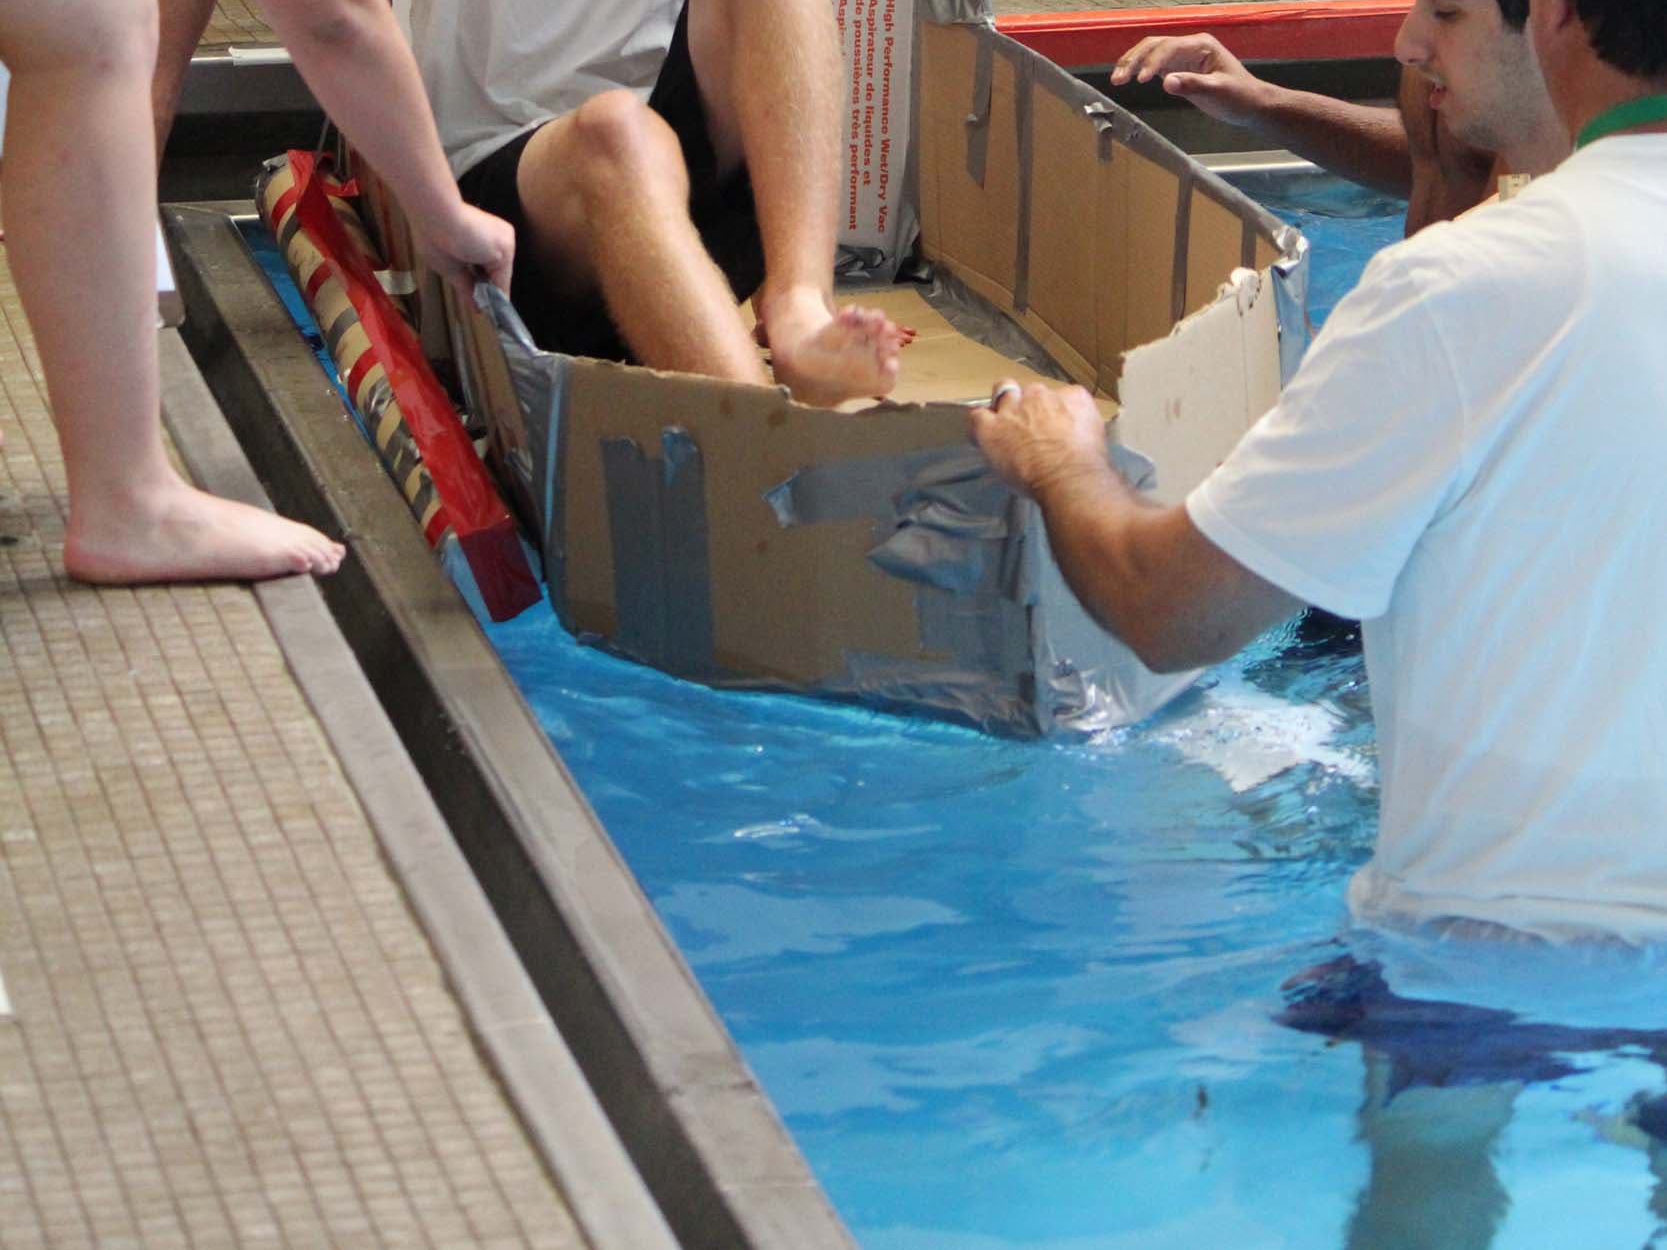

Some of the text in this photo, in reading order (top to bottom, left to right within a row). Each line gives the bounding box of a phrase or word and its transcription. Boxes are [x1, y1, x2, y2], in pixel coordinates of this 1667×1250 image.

[852, 20, 862, 105] poussières
[865, 82, 875, 101] de
[881, 37, 894, 134] Performance
[851, 109, 861, 140] très
[863, 106, 874, 166] liquides
[849, 144, 860, 230] performant
[863, 170, 871, 186] et
[878, 138, 891, 201] Wet/Dry
[878, 205, 888, 233] Vac
